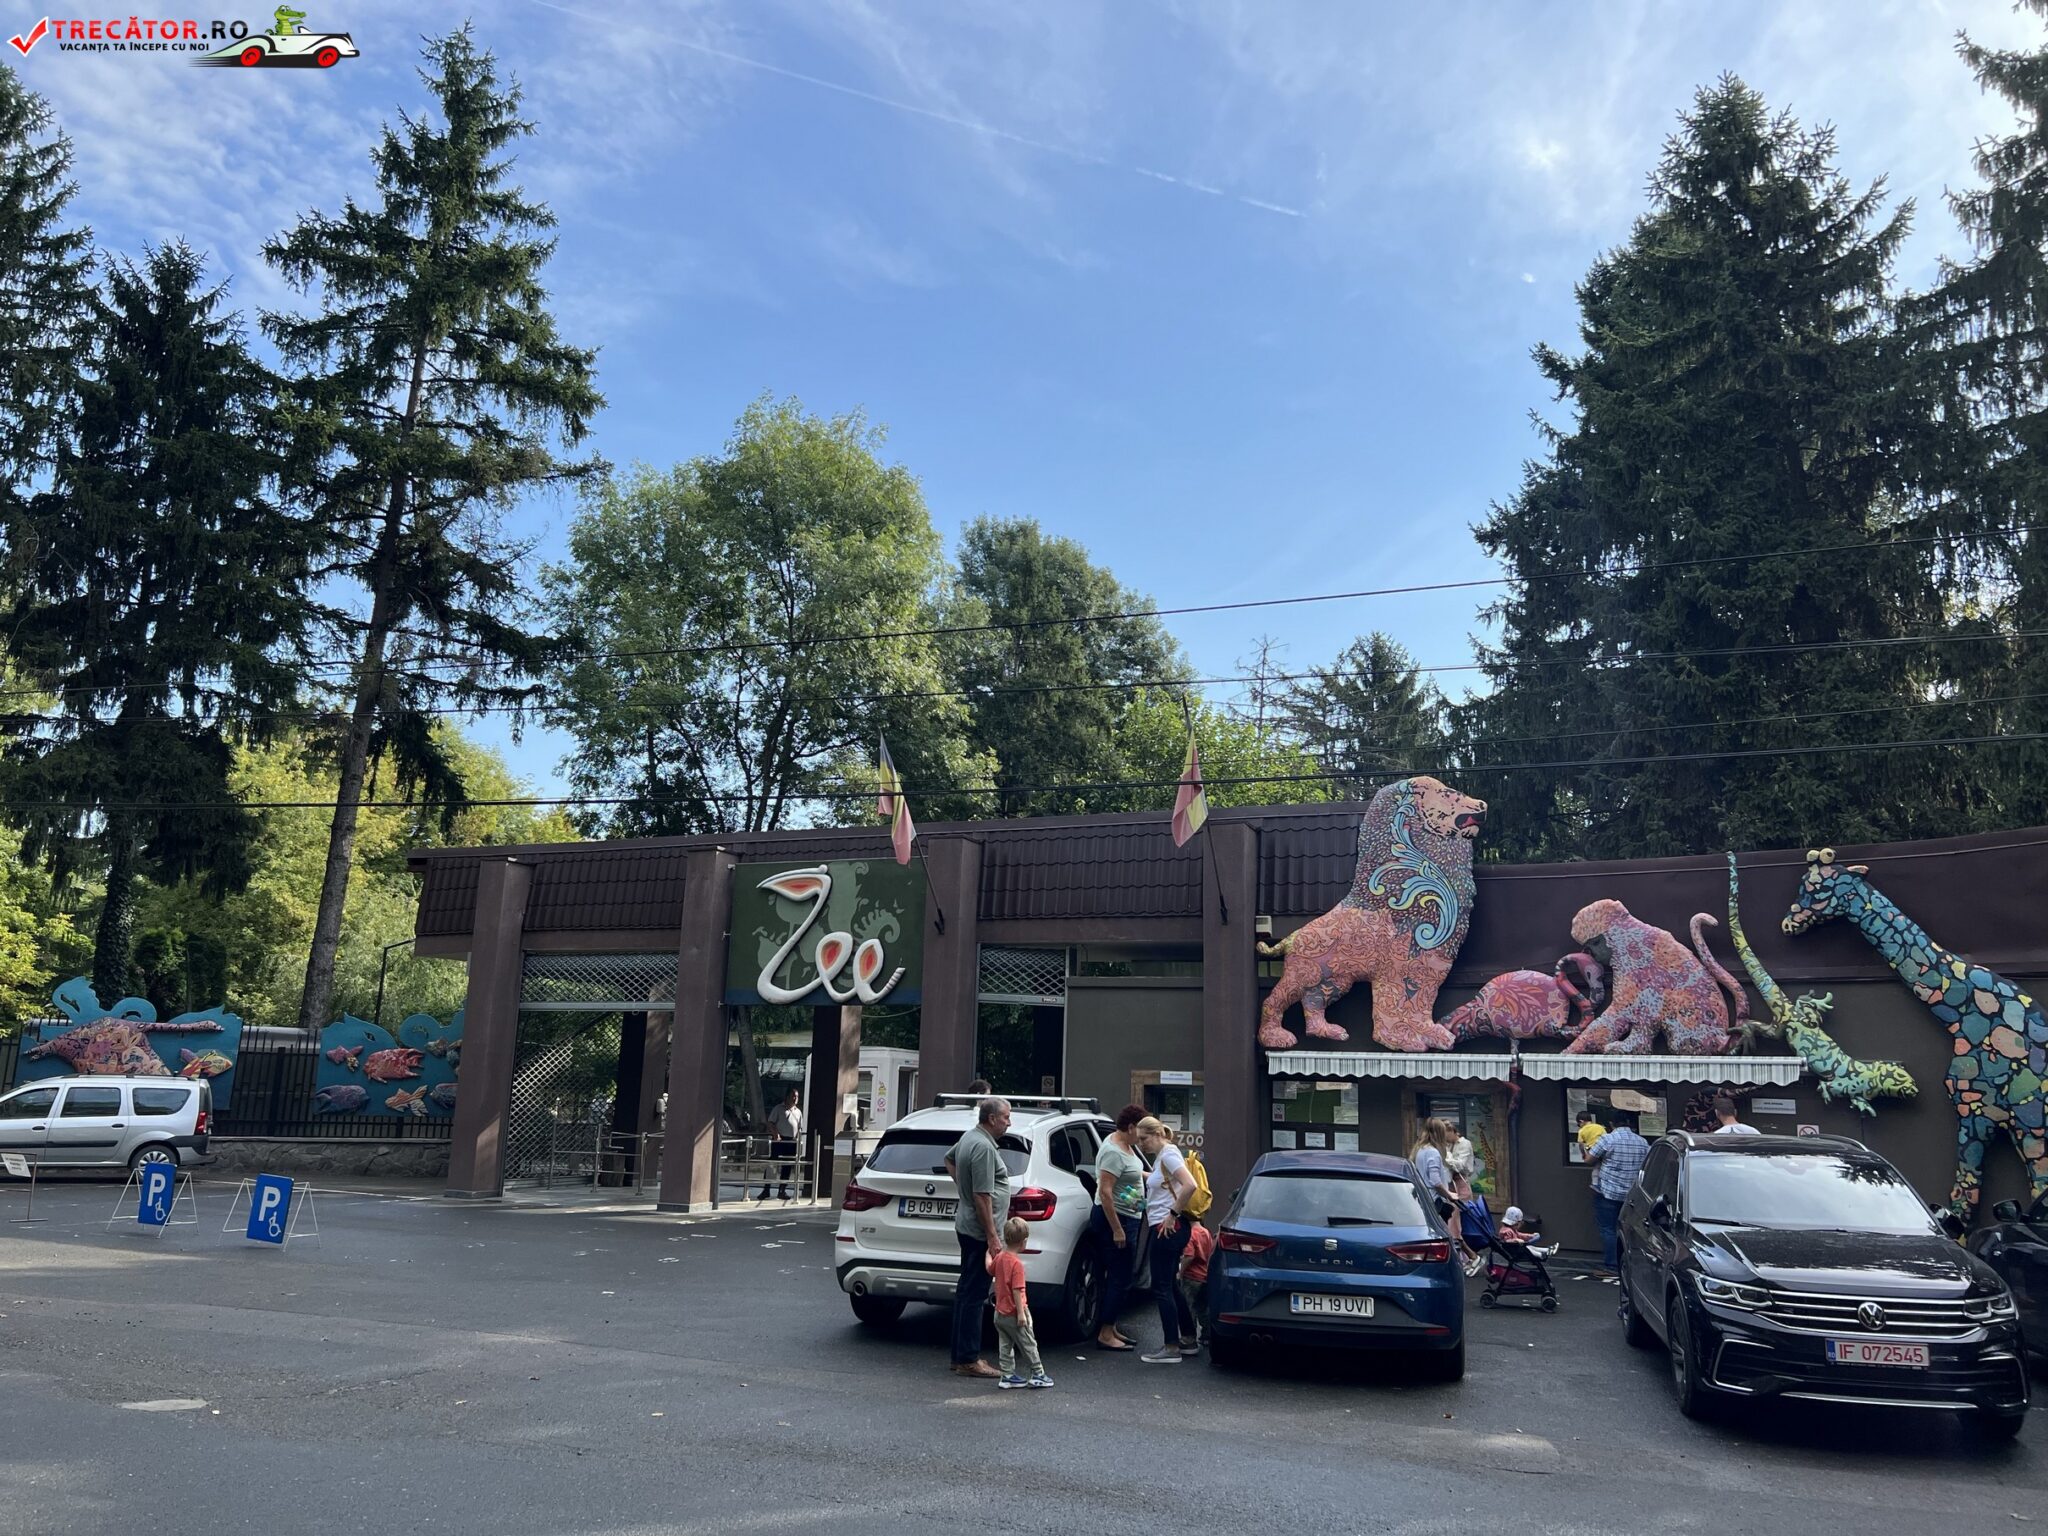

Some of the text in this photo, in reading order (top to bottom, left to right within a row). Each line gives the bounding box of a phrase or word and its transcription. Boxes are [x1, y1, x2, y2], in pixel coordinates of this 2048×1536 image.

[1177, 1134, 1204, 1147] ZOO
[147, 1173, 166, 1207] P
[258, 1186, 281, 1222] P
[907, 1200, 915, 1212] B
[919, 1201, 933, 1213] 09
[1303, 1297, 1368, 1313] PH 19 UVI
[1839, 1343, 1924, 1363] IF 072545
